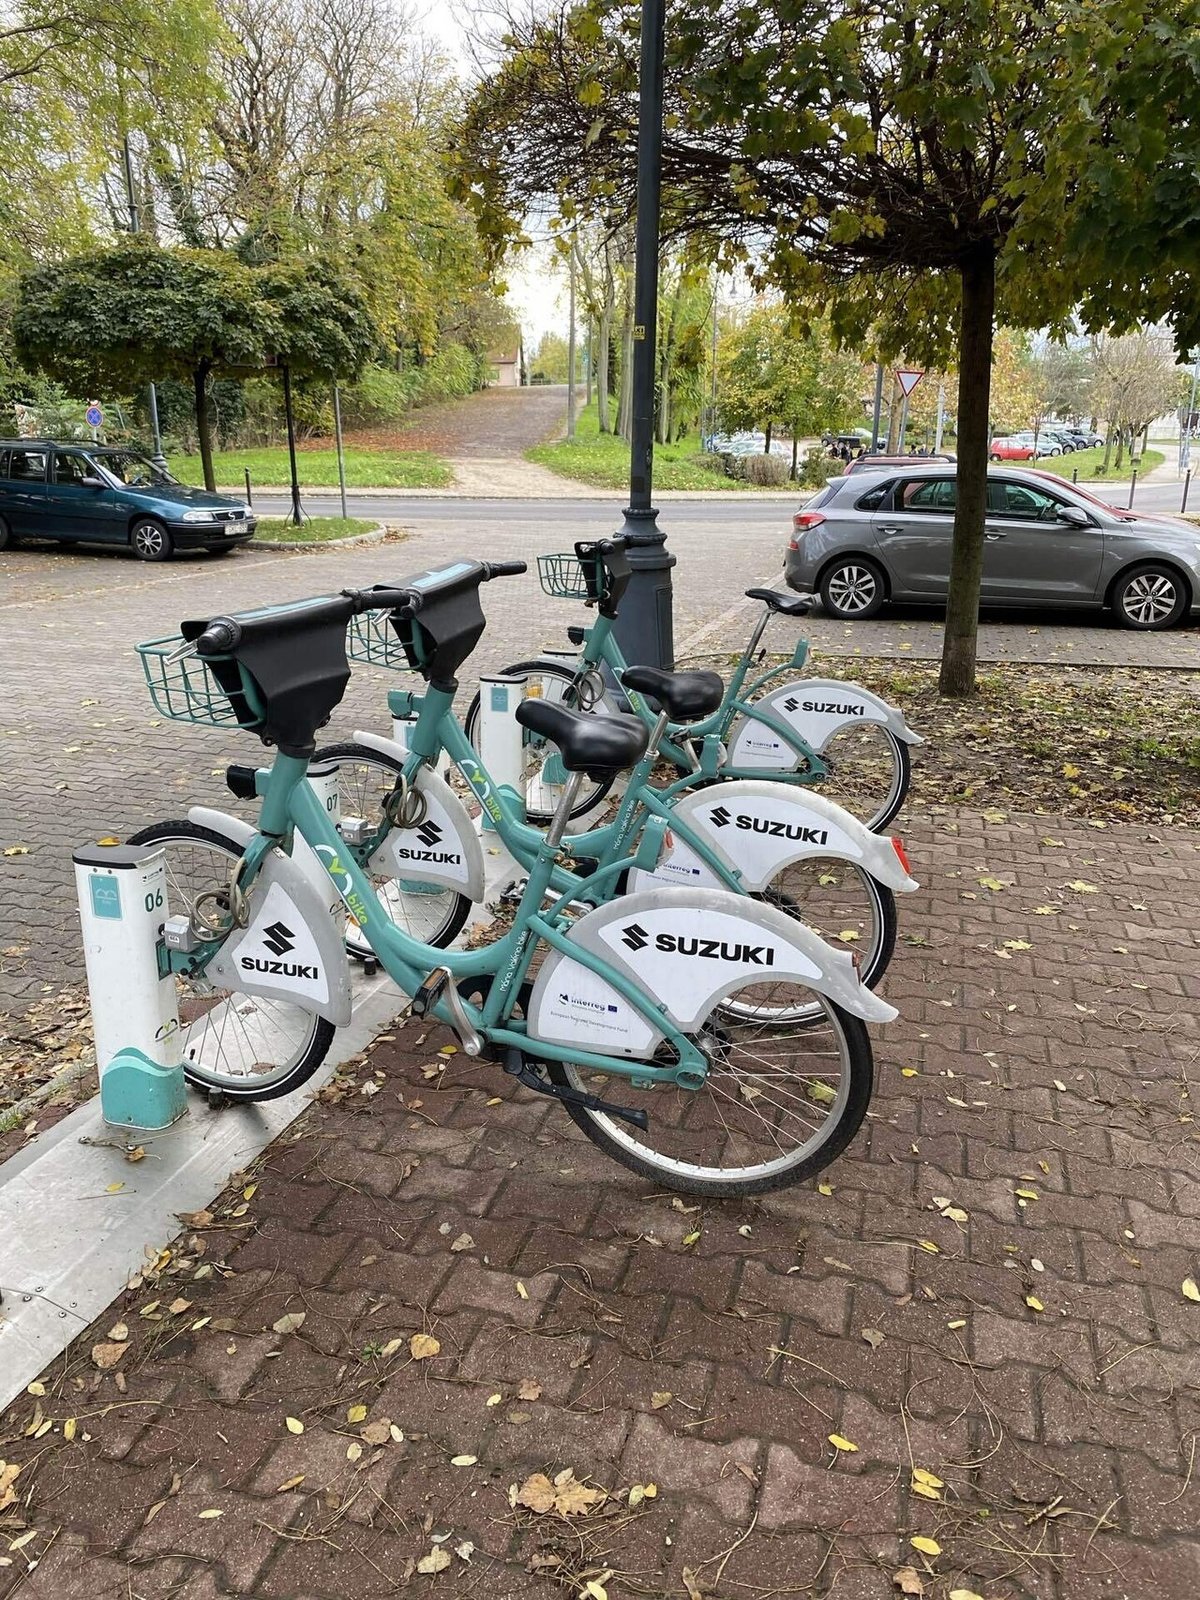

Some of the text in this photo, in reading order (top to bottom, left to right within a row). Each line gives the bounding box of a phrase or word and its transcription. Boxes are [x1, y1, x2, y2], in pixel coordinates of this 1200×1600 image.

[801, 701, 865, 716] SUZUKI
[326, 793, 338, 812] 07
[735, 814, 828, 846] SUZUKI
[398, 848, 461, 865] SUZUKI
[144, 887, 164, 913] 06
[347, 893, 368, 924] bike
[655, 933, 775, 966] SUZUKI
[241, 956, 319, 980] SUZUKI
